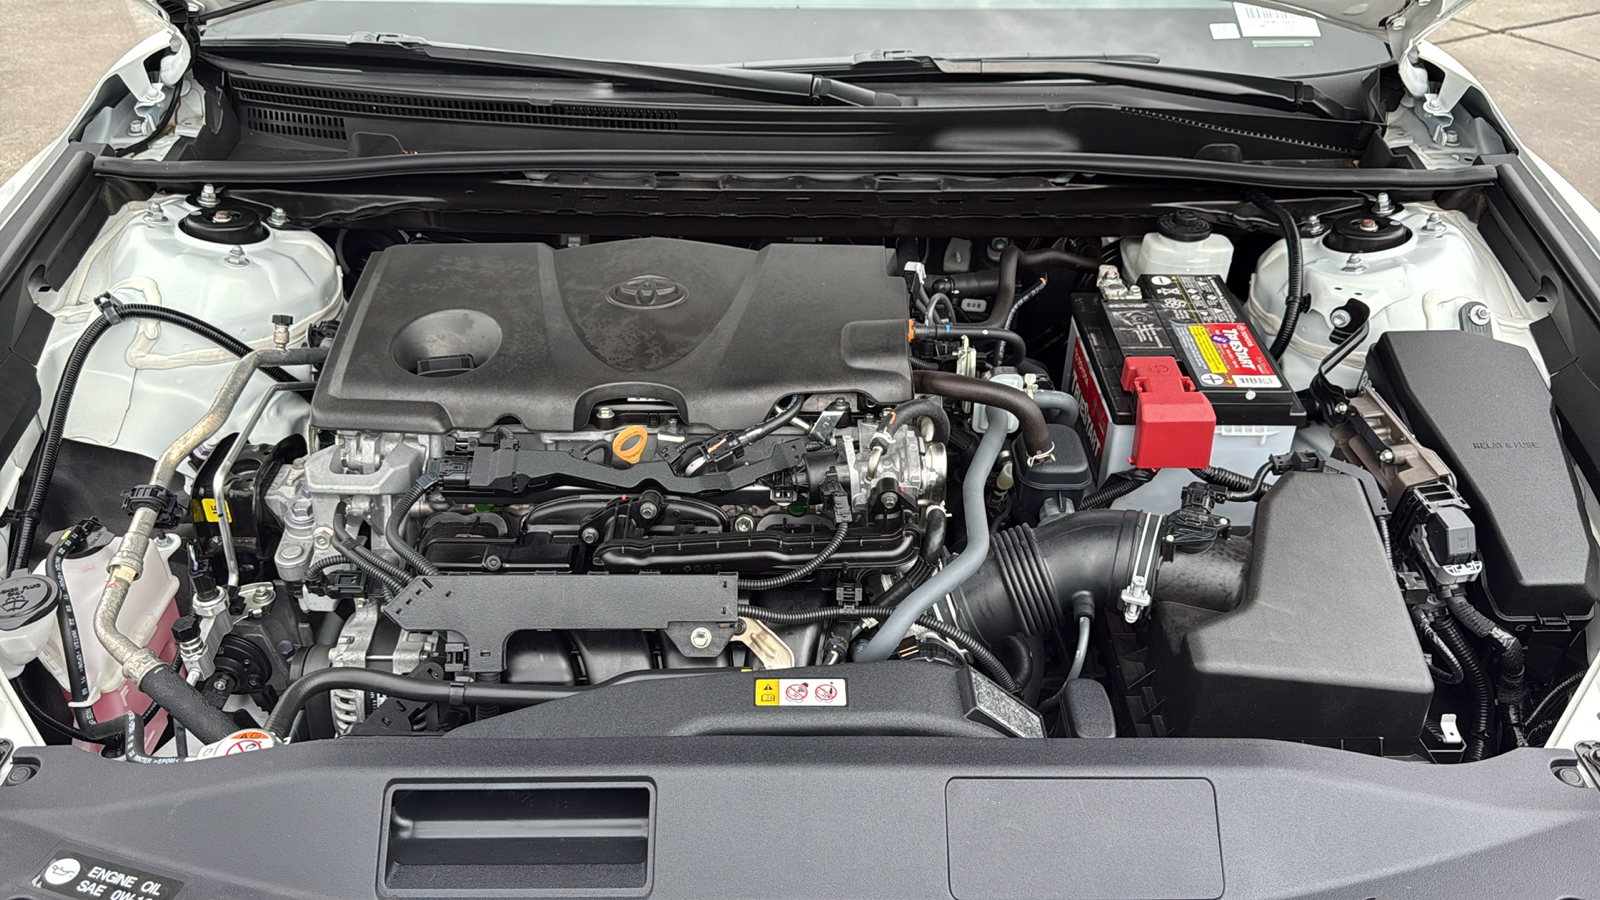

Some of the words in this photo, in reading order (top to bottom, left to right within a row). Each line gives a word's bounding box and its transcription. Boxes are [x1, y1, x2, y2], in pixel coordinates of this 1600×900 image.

[1241, 331, 1254, 347] TOYOTA
[1473, 441, 1503, 450] RELAY
[1513, 441, 1540, 449] FUSE
[68, 617, 76, 626] 22
[71, 628, 80, 651] WATER
[76, 880, 107, 897] SAE
[109, 889, 153, 900] 0W-
[87, 866, 138, 888] ENGINE
[140, 881, 162, 896] OIL
